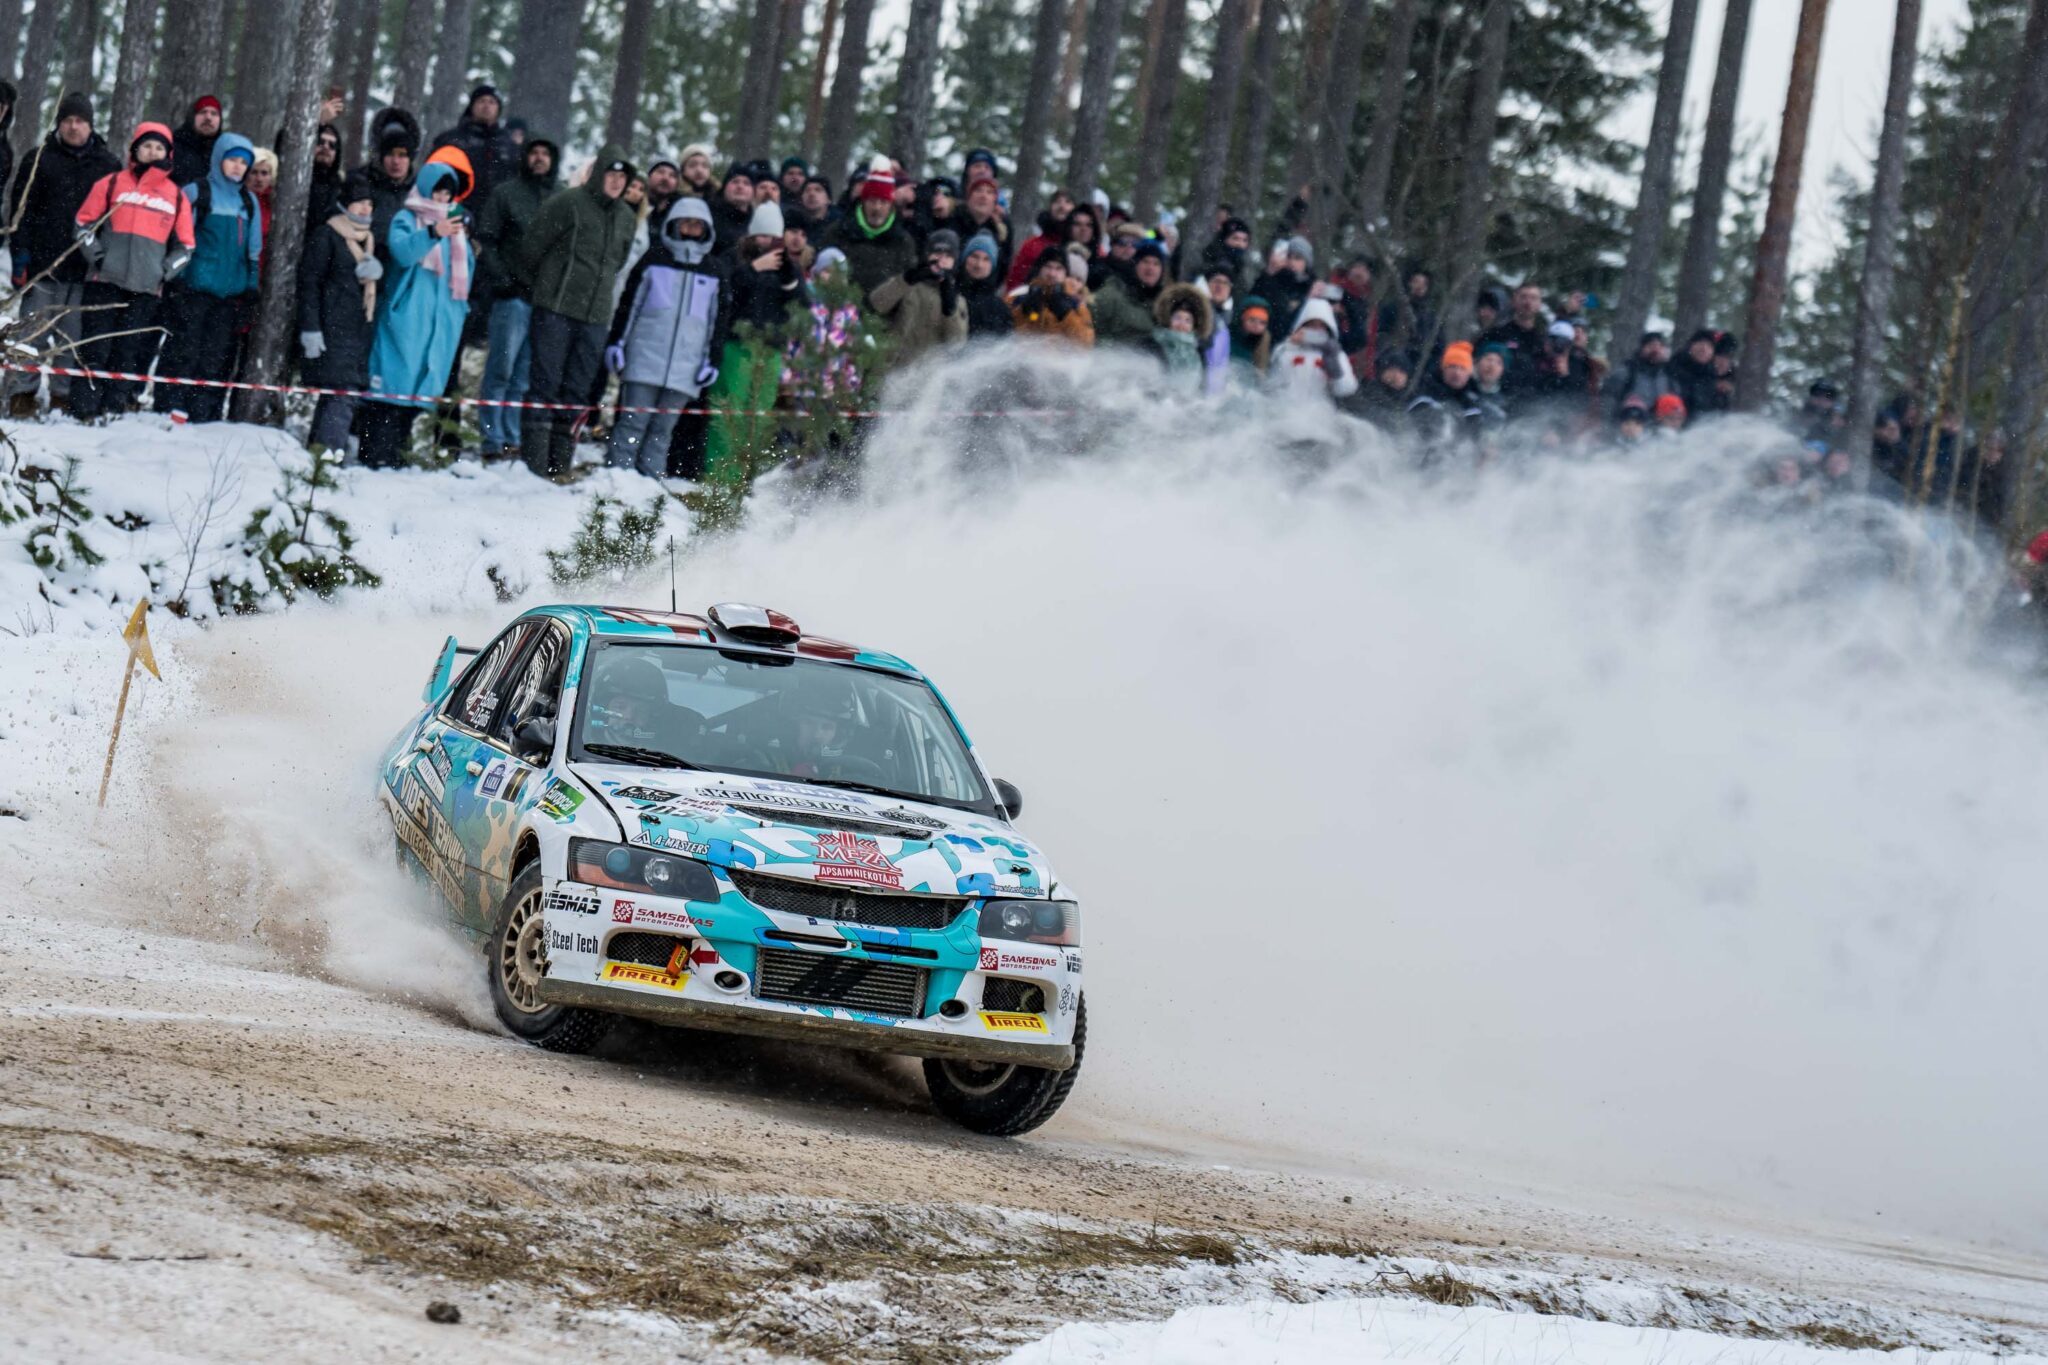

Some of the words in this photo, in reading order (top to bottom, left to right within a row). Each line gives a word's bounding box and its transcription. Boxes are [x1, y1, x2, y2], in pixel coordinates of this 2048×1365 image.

[546, 784, 576, 812] Europcar
[653, 834, 710, 855] A-MASTERS
[634, 916, 690, 930] MOTORSPORT
[636, 903, 716, 928] SAMSONAS
[551, 929, 574, 952] Steel
[576, 932, 599, 955] Tech
[1000, 963, 1043, 971] MOTORSPORT
[1001, 954, 1058, 967] SAMSONAS
[609, 964, 681, 987] PIRELLI
[985, 1014, 1043, 1029] PIRELLI
